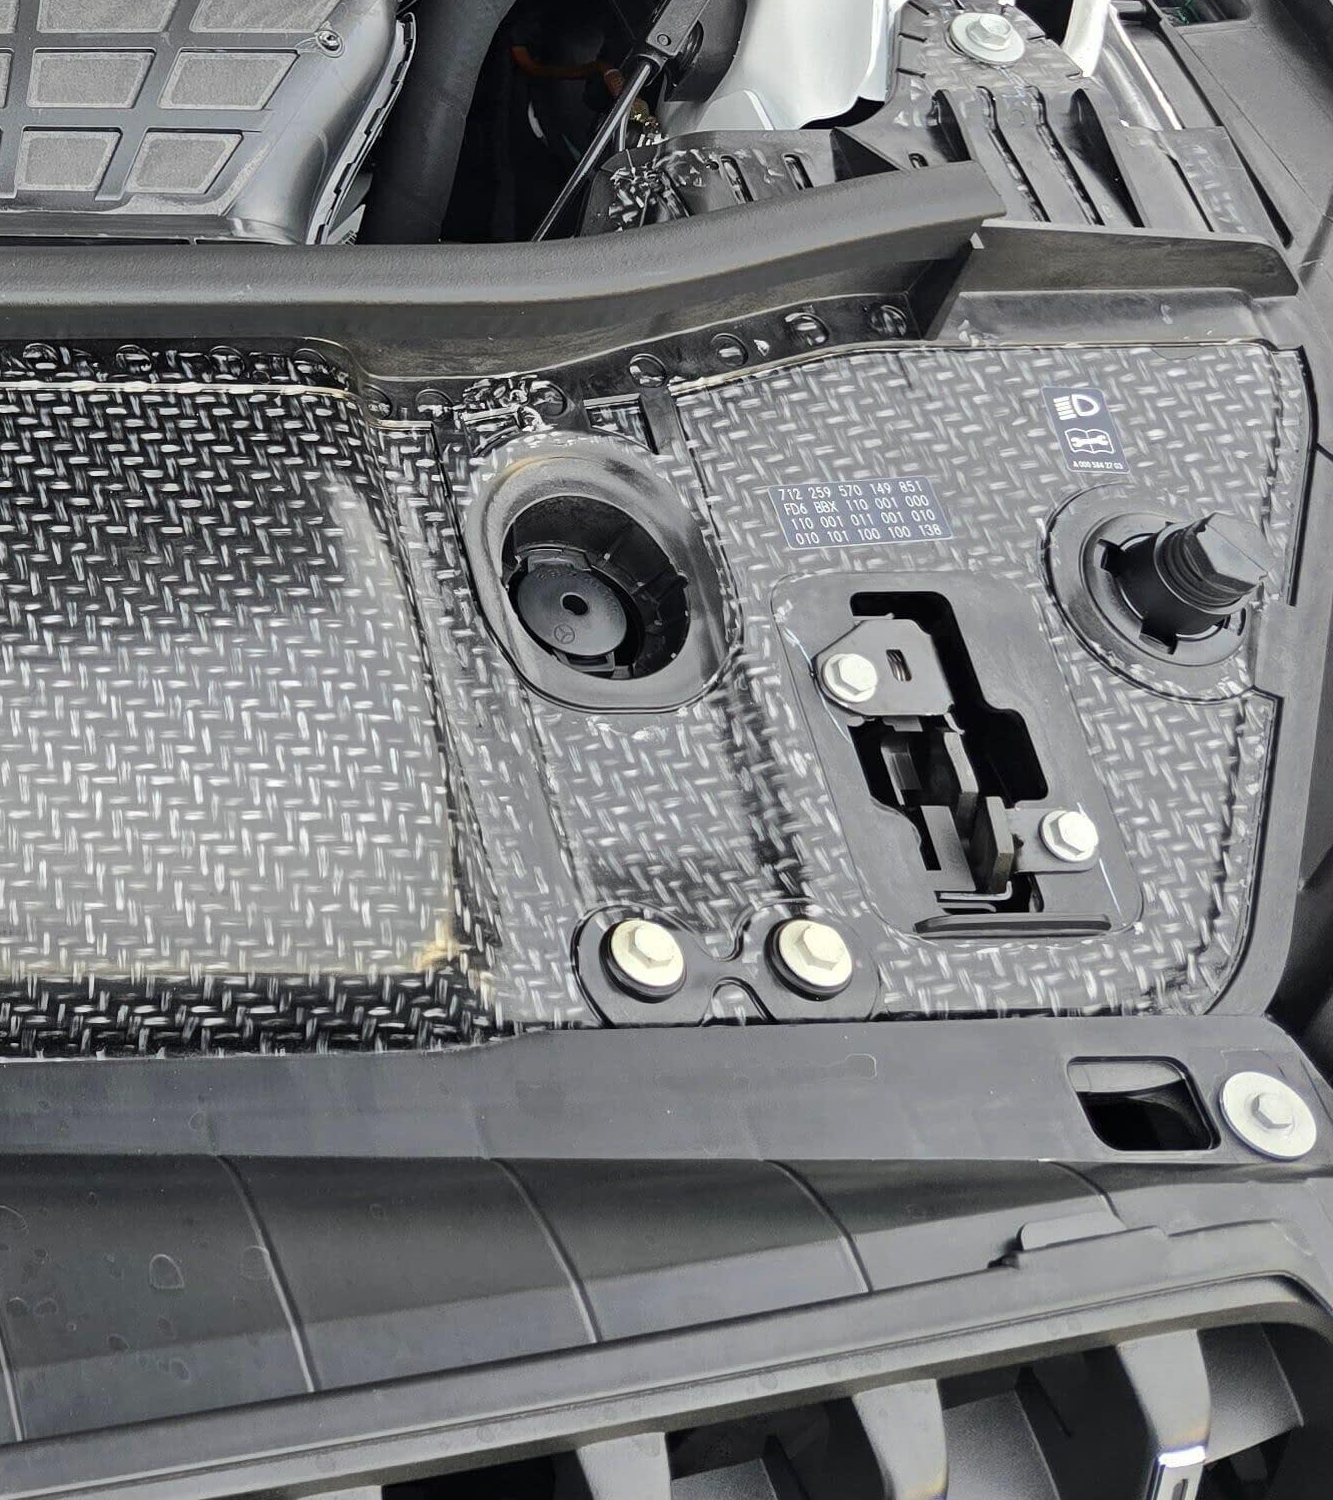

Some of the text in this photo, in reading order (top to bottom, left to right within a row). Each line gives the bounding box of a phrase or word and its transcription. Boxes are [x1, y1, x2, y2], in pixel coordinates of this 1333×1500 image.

[1079, 461, 1092, 469] 000
[777, 480, 923, 501] 712 259 570 149 851
[784, 494, 930, 516] FD6 BBX 110 001 000
[791, 508, 936, 531] 110 001 011 001 010
[795, 523, 942, 545] 010 101 100 100 138
